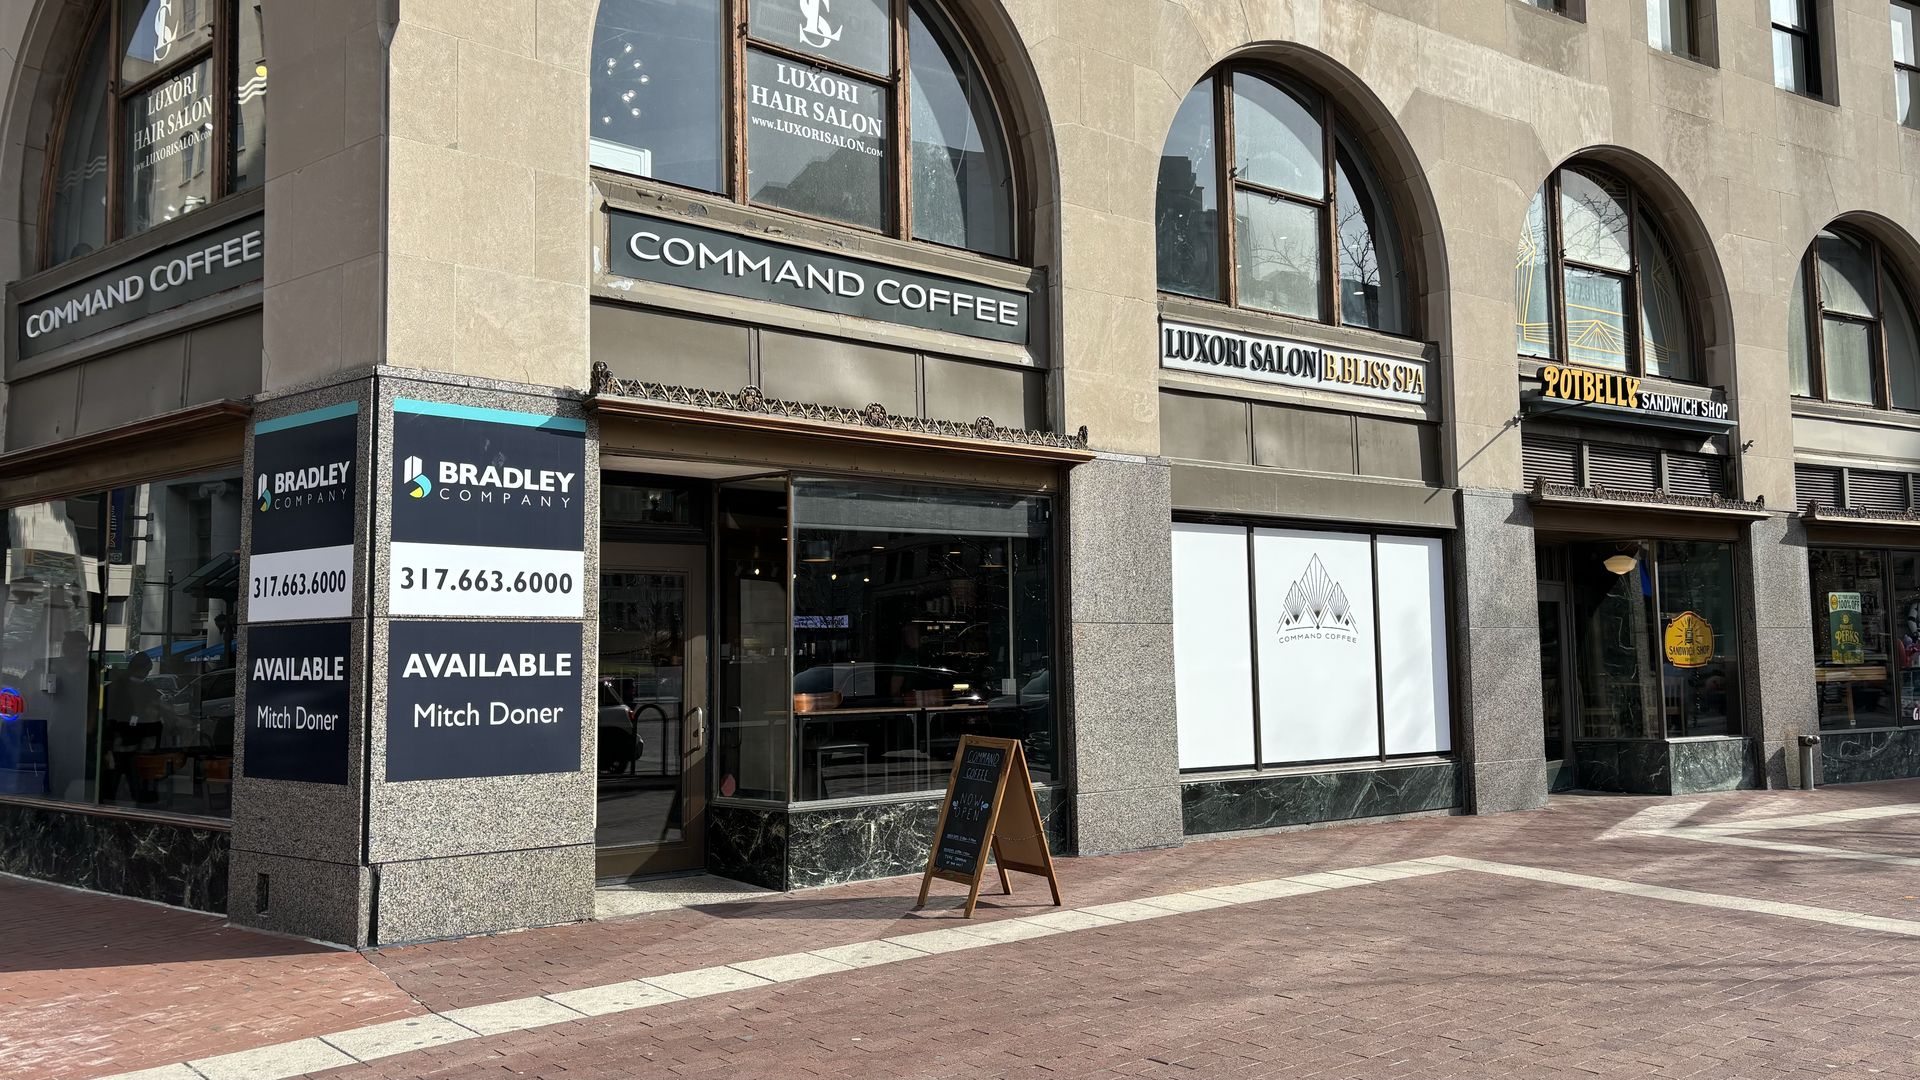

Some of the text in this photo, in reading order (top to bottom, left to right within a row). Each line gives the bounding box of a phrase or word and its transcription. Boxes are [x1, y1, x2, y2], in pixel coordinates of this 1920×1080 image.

[147, 72, 198, 116] LUXORI
[777, 64, 859, 104] LUXORI
[134, 95, 213, 152] HAIR SALON
[751, 85, 883, 137] HAIR SALON
[26, 231, 263, 339] COMMAND COFFEE
[629, 231, 1019, 327] COMMAND COFFEE
[1165, 327, 1247, 369] LUXORI
[1251, 341, 1318, 378] SALON
[1393, 365, 1425, 395] SPA
[1543, 365, 1729, 419] POTBELLY SANDWICH SHOP
[274, 460, 350, 495] BRADLEY
[439, 461, 576, 493] BRADLEY
[274, 486, 348, 511] COMPANY
[439, 487, 571, 509] COMPANY
[253, 569, 347, 599] 317.663.6000
[400, 567, 573, 595] 317.663.6000
[1278, 632, 1357, 644] COMMAND COFFEE
[1668, 645, 1710, 656] SANDWICH SHOP
[1835, 629, 1860, 645] PERKS
[253, 656, 344, 682] AVAILABLE
[402, 653, 572, 679] AVAILABLE
[257, 704, 339, 731] Mitch Doner
[414, 701, 563, 729] Mitch Doner
[967, 750, 1000, 767] COMMAND
[966, 767, 989, 781] COFFEE
[960, 792, 983, 807] NOW
[954, 807, 980, 822] OPEN
